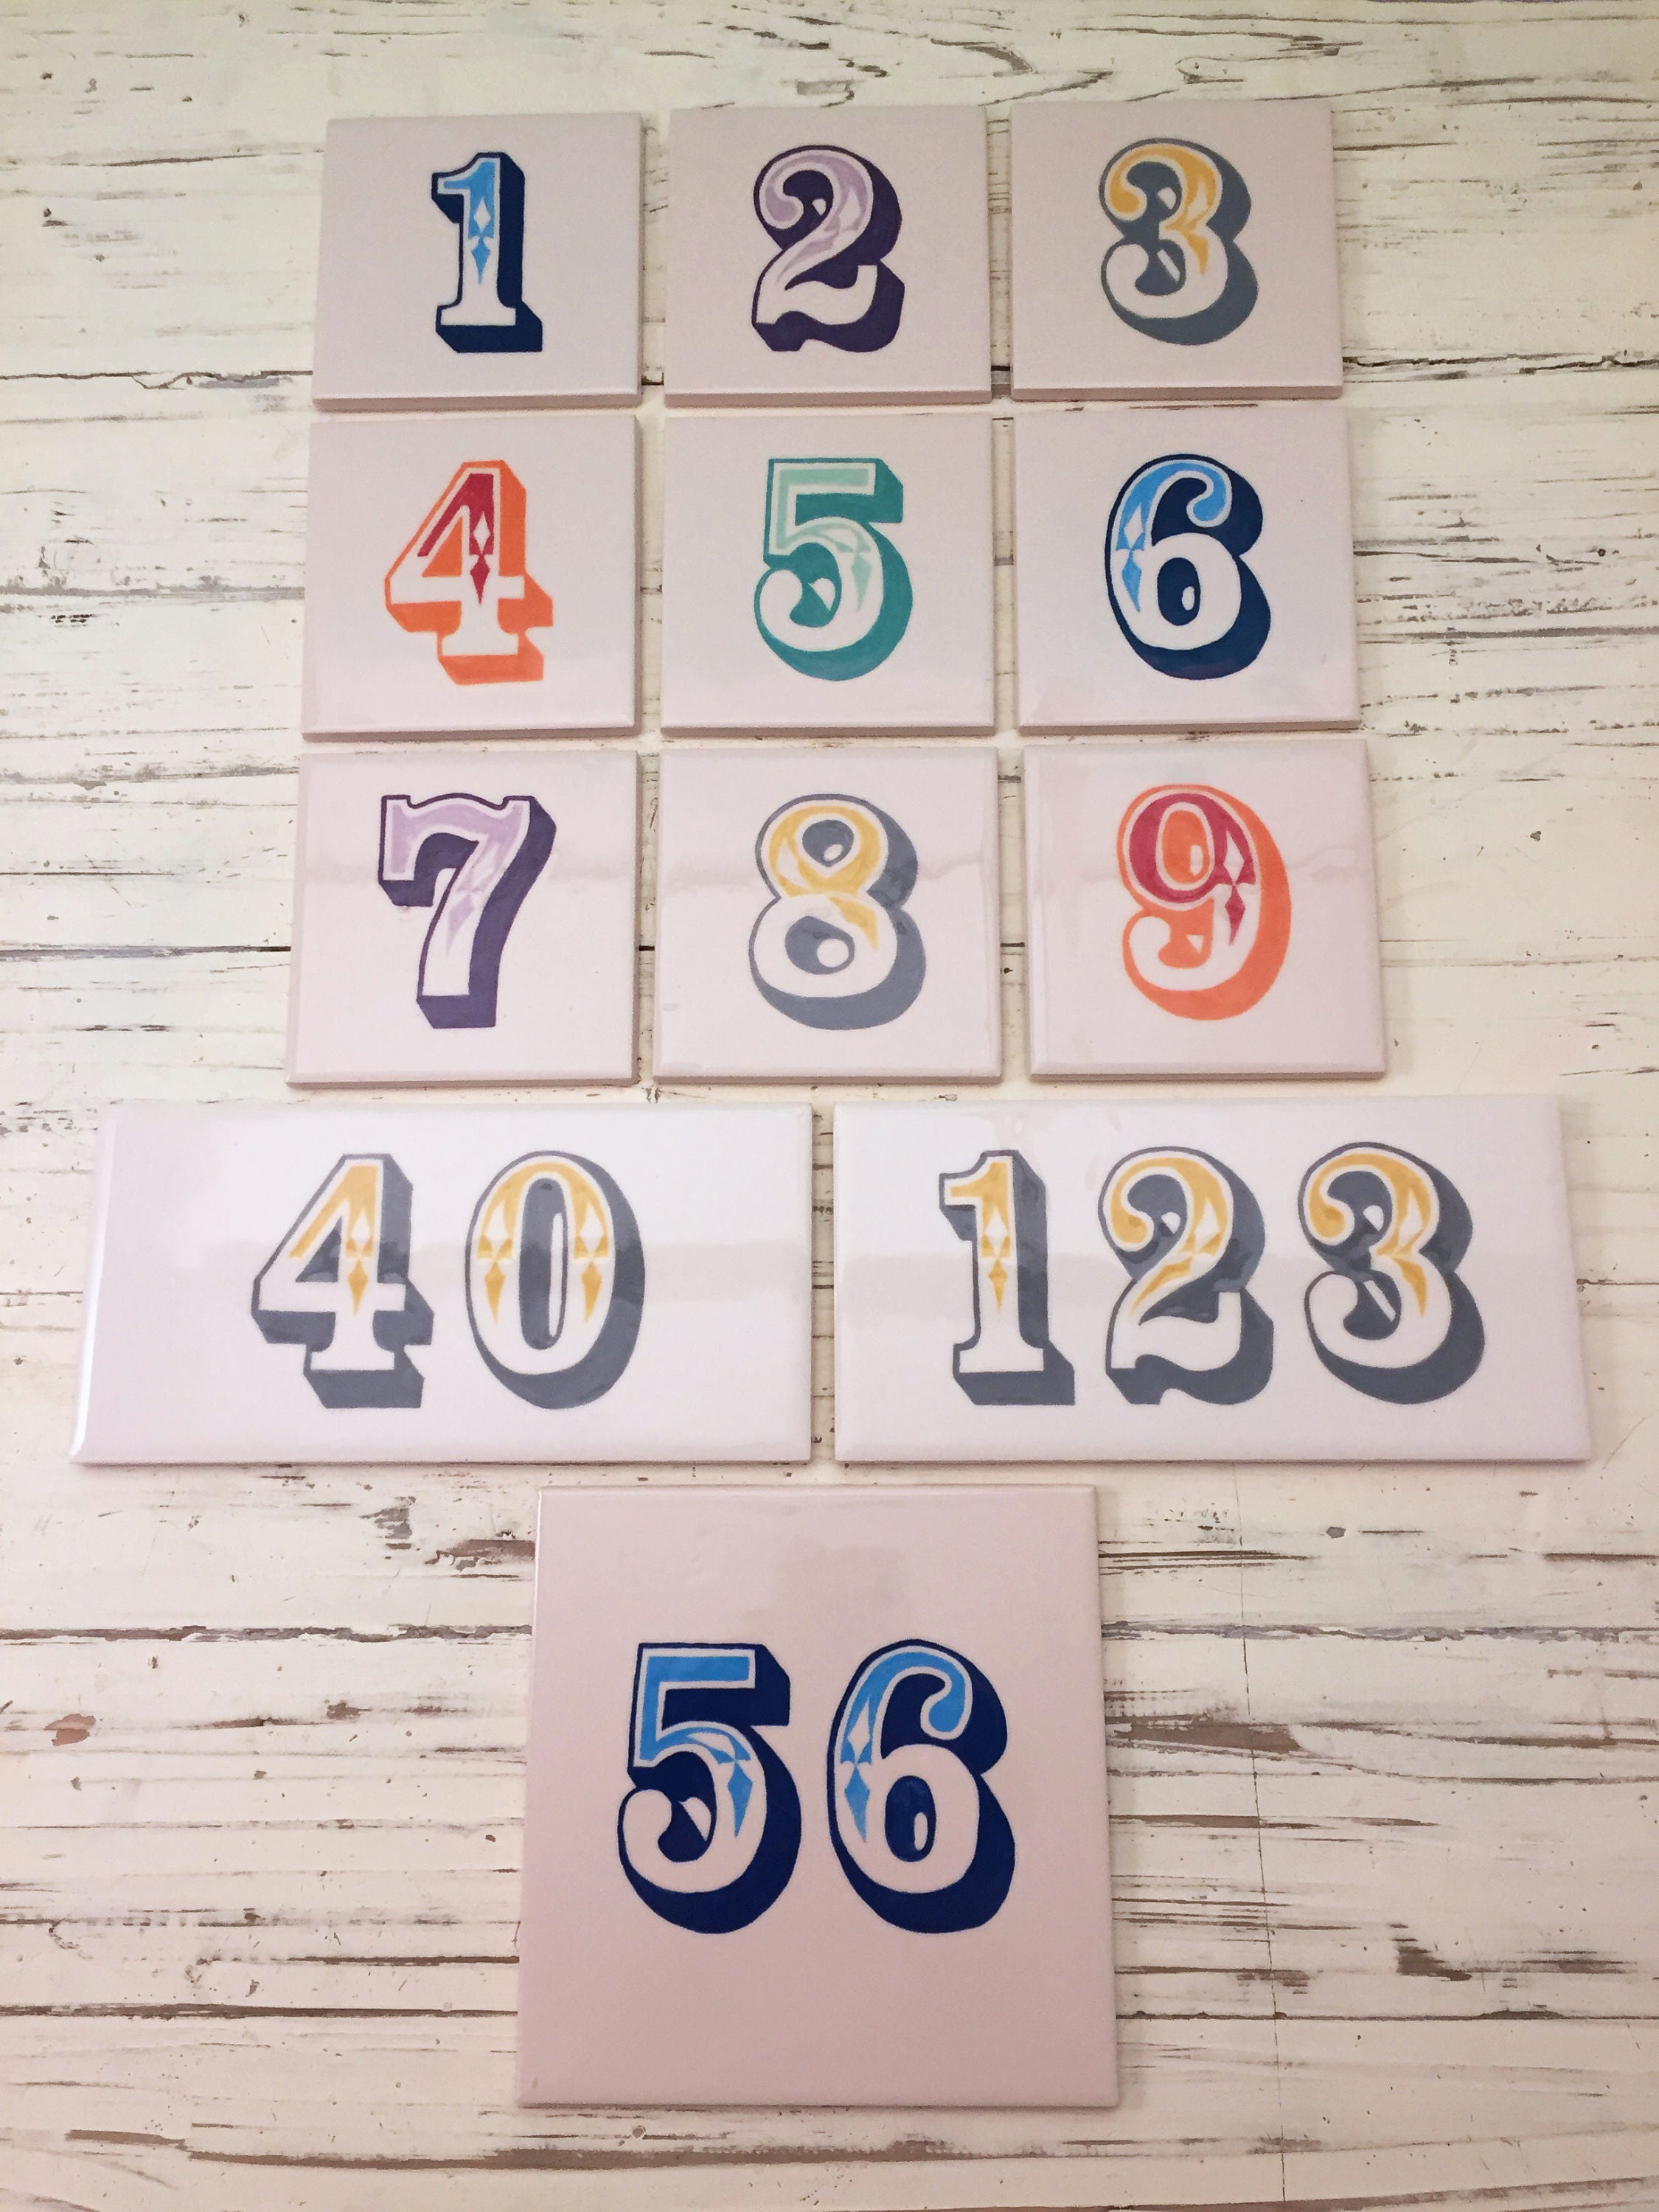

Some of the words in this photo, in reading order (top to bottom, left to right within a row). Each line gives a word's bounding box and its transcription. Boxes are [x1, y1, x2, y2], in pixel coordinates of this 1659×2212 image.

[431, 152, 542, 353] 1
[752, 145, 904, 352] 2
[1099, 139, 1258, 345] 3
[385, 460, 553, 684] 4
[755, 458, 912, 681] 5
[1105, 454, 1270, 680] 6
[378, 793, 556, 1029] 7
[749, 794, 925, 1029] 8
[1117, 785, 1291, 1020] 9
[251, 1152, 644, 1409] 40
[939, 1143, 1484, 1405] 123
[618, 1639, 1015, 1933] 56
